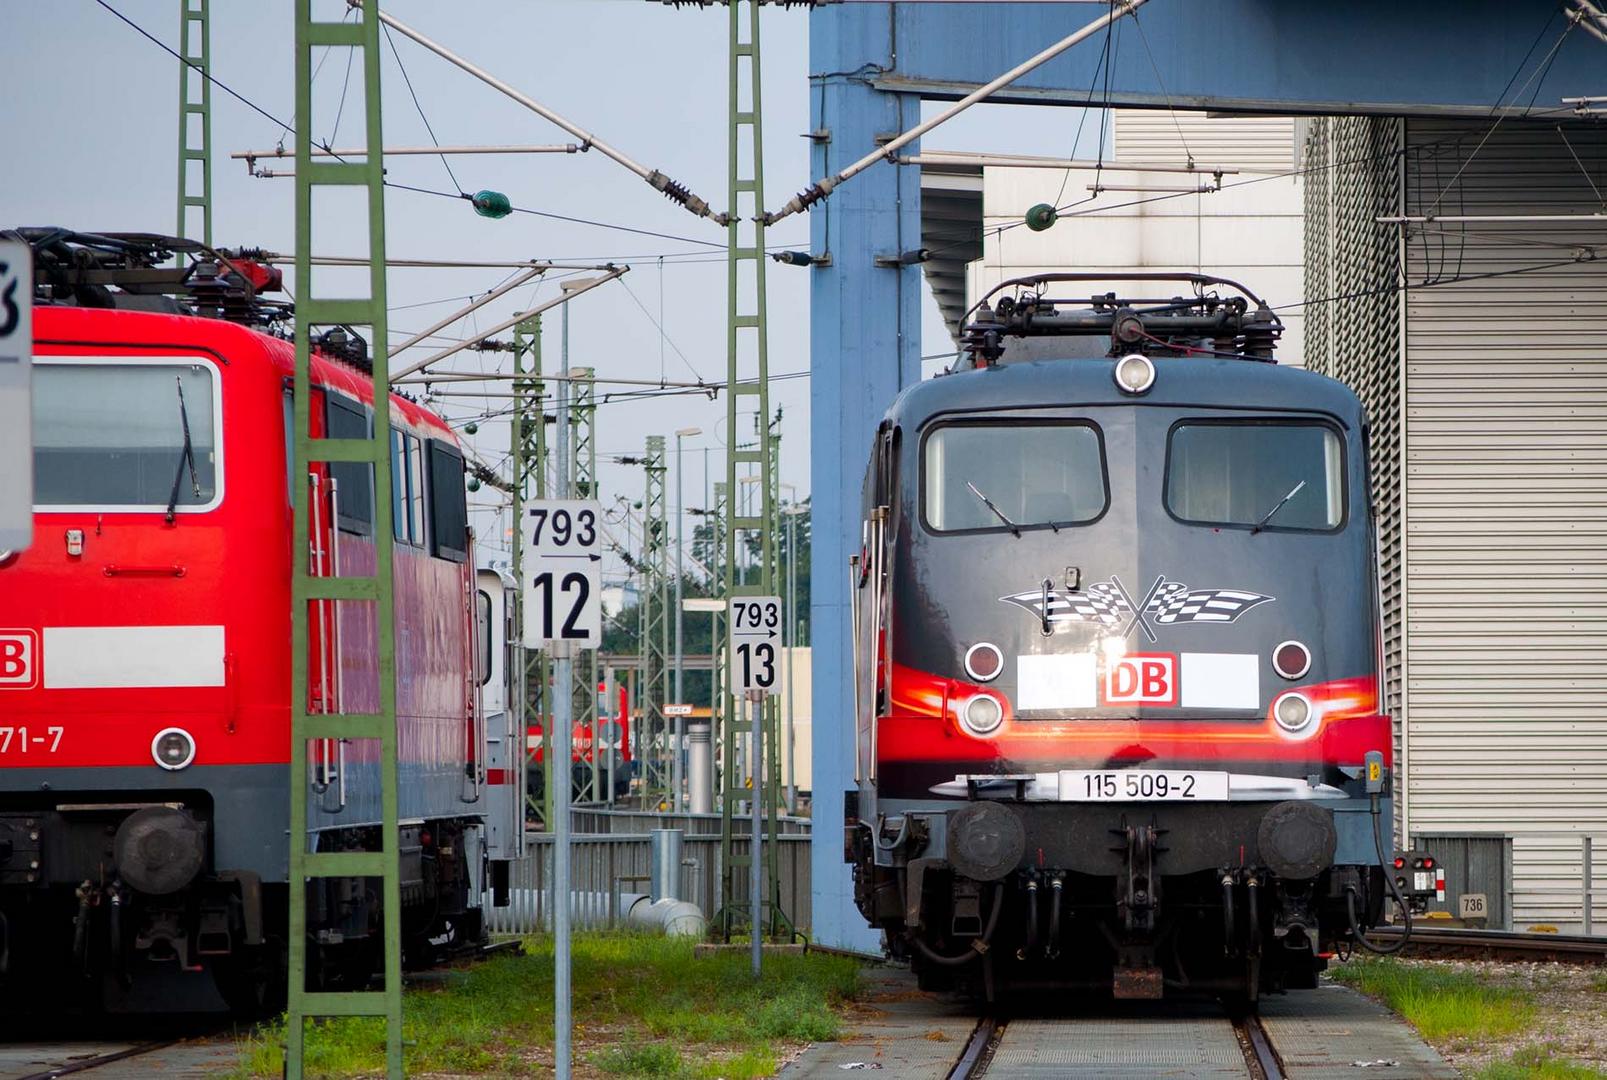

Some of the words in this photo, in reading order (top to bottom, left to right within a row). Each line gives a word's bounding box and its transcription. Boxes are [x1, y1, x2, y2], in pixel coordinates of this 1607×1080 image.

[529, 509, 597, 547] 793
[533, 572, 590, 639] 12
[733, 602, 778, 628] 793
[736, 643, 775, 688] 13
[1111, 662, 1168, 697] DB
[1083, 775, 1116, 797] 115
[1126, 775, 1195, 797] 509-2
[1464, 899, 1483, 912] 736
